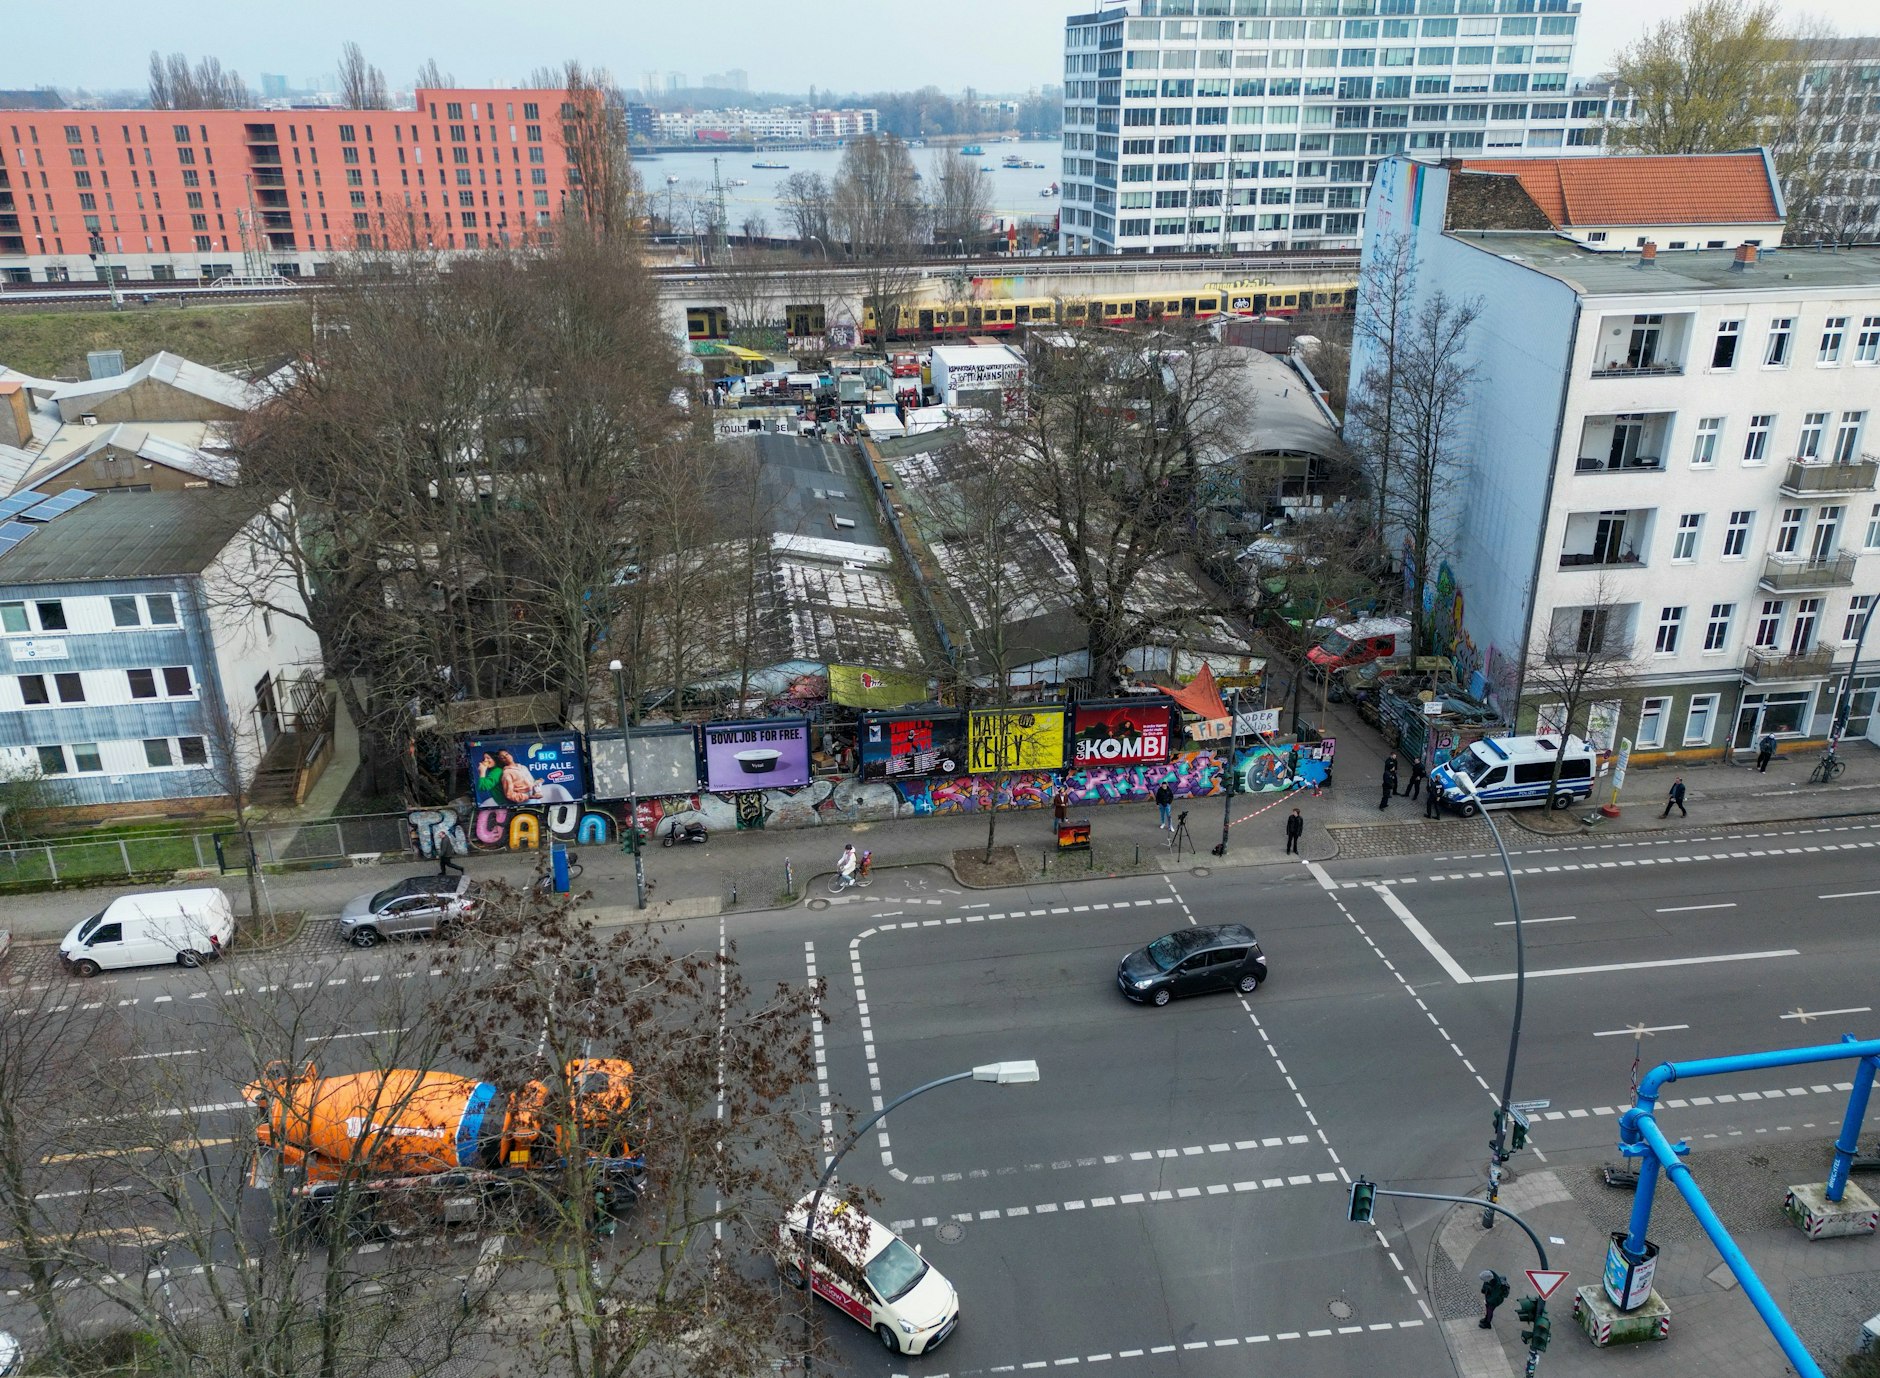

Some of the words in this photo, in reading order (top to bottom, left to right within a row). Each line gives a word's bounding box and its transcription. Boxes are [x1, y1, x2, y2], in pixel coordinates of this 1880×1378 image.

[760, 730, 777, 741] FOR
[779, 729, 802, 740] FREE.
[1076, 740, 1086, 760] GIGA
[1085, 736, 1166, 760] KOMBI
[538, 752, 556, 760] BIO
[529, 762, 548, 771] FÜR
[550, 762, 574, 770] ALLE.
